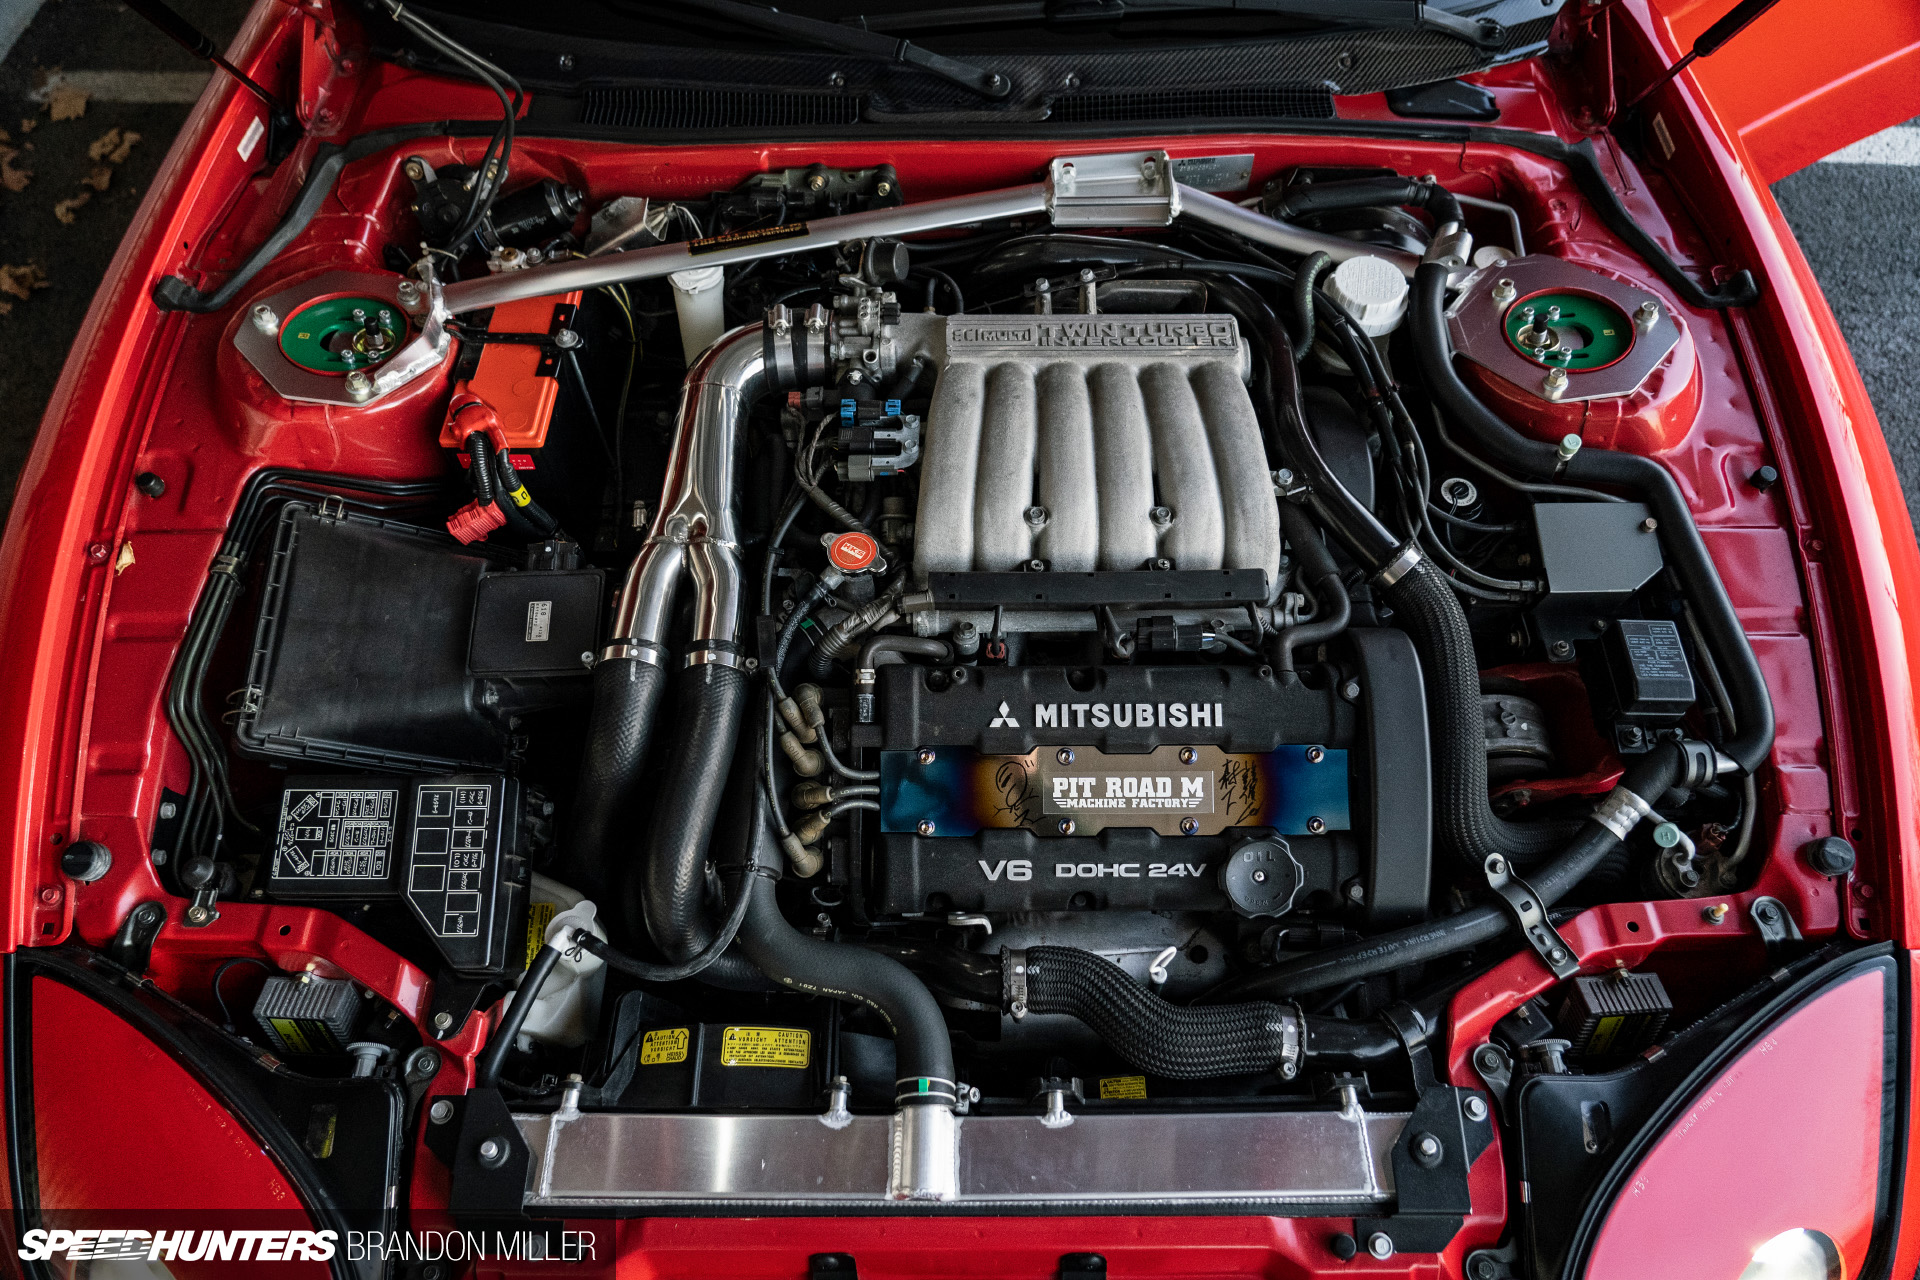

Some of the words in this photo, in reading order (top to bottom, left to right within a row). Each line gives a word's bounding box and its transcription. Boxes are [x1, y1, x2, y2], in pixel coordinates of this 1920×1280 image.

[982, 329, 1031, 341] MULTI
[1040, 323, 1121, 336] TWIN
[1124, 323, 1232, 337] TURBO
[1040, 336, 1232, 347] INTERCOOLER
[842, 543, 866, 556] HKS
[1036, 704, 1223, 728] MITSUBISHI
[1052, 777, 1096, 798] PIT
[1106, 777, 1172, 798] ROAD
[1181, 777, 1203, 798] M
[1066, 798, 1126, 808] MACHINE
[1132, 798, 1188, 808] FACTORY
[1243, 851, 1276, 862] OIL
[978, 860, 1033, 881] V6
[1056, 864, 1140, 877] DOHC
[1148, 863, 1207, 877] 24V
